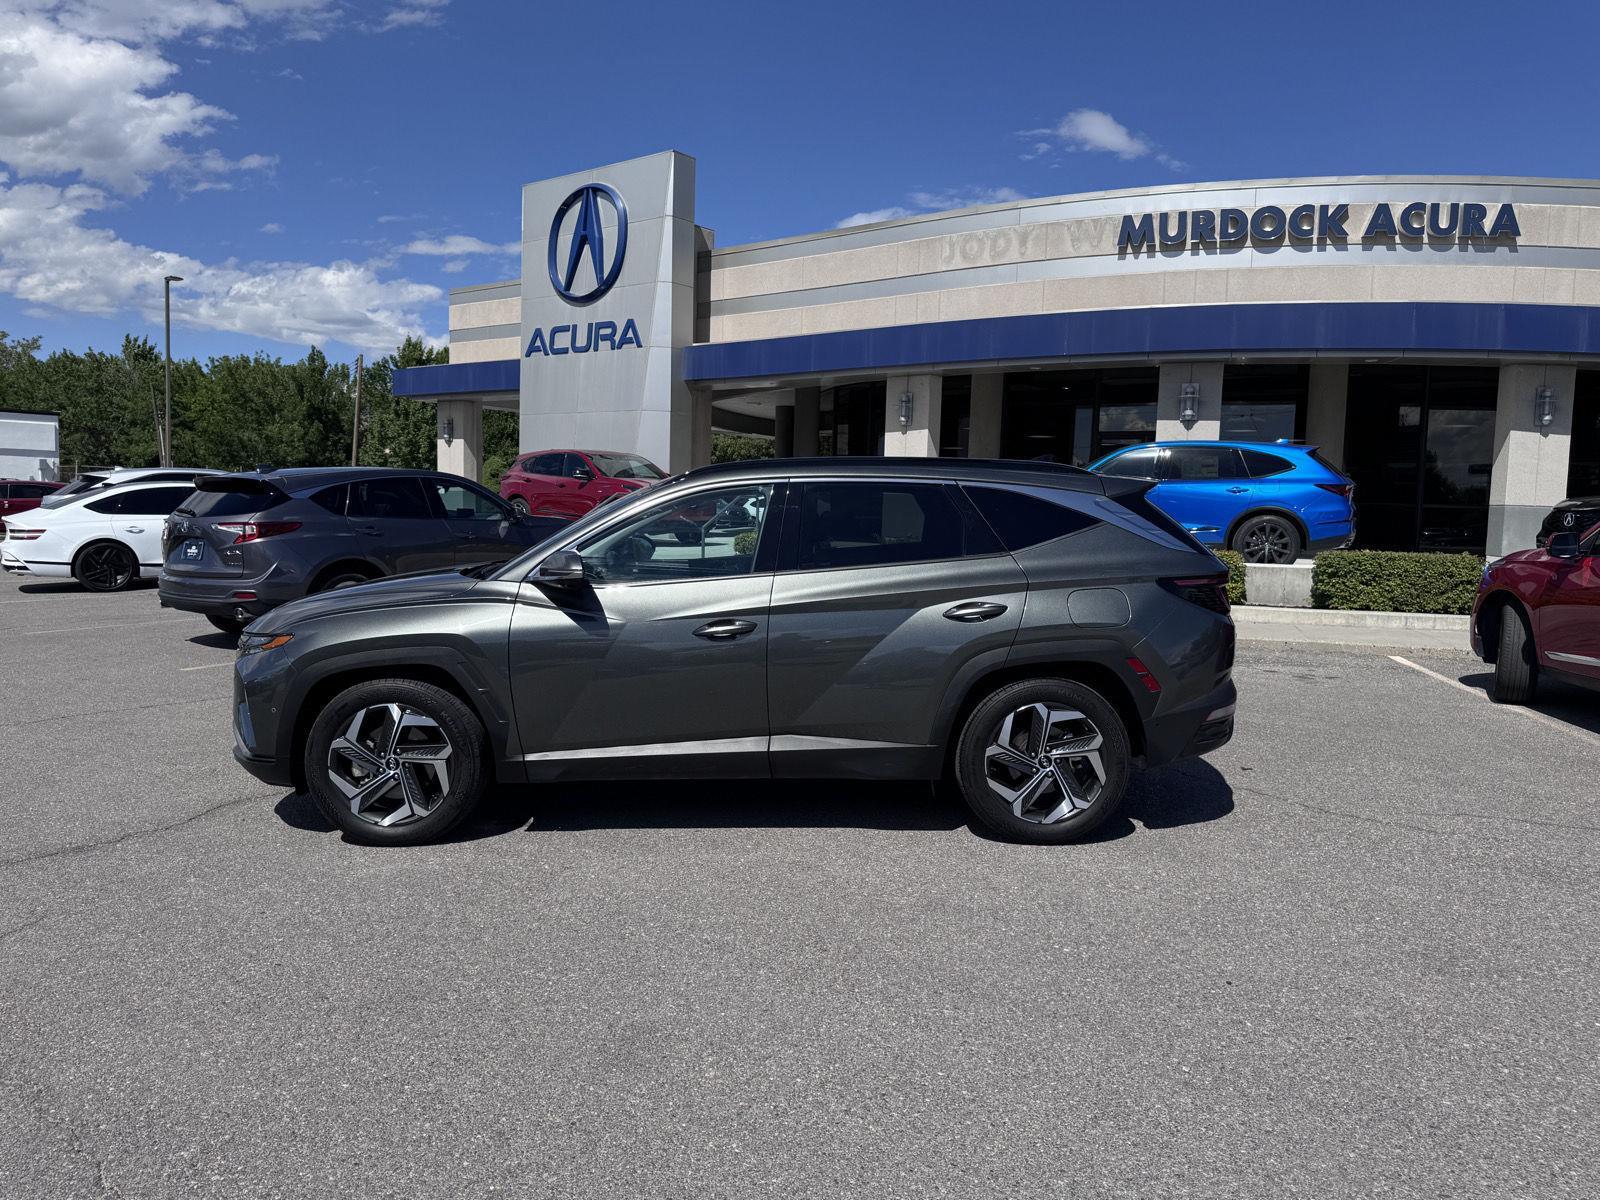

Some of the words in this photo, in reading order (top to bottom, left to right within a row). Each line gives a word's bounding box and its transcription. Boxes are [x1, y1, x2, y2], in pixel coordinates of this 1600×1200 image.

[1117, 203, 1349, 247] MURDOCK
[1361, 202, 1521, 238] ACURA
[525, 318, 643, 358] ACURA
